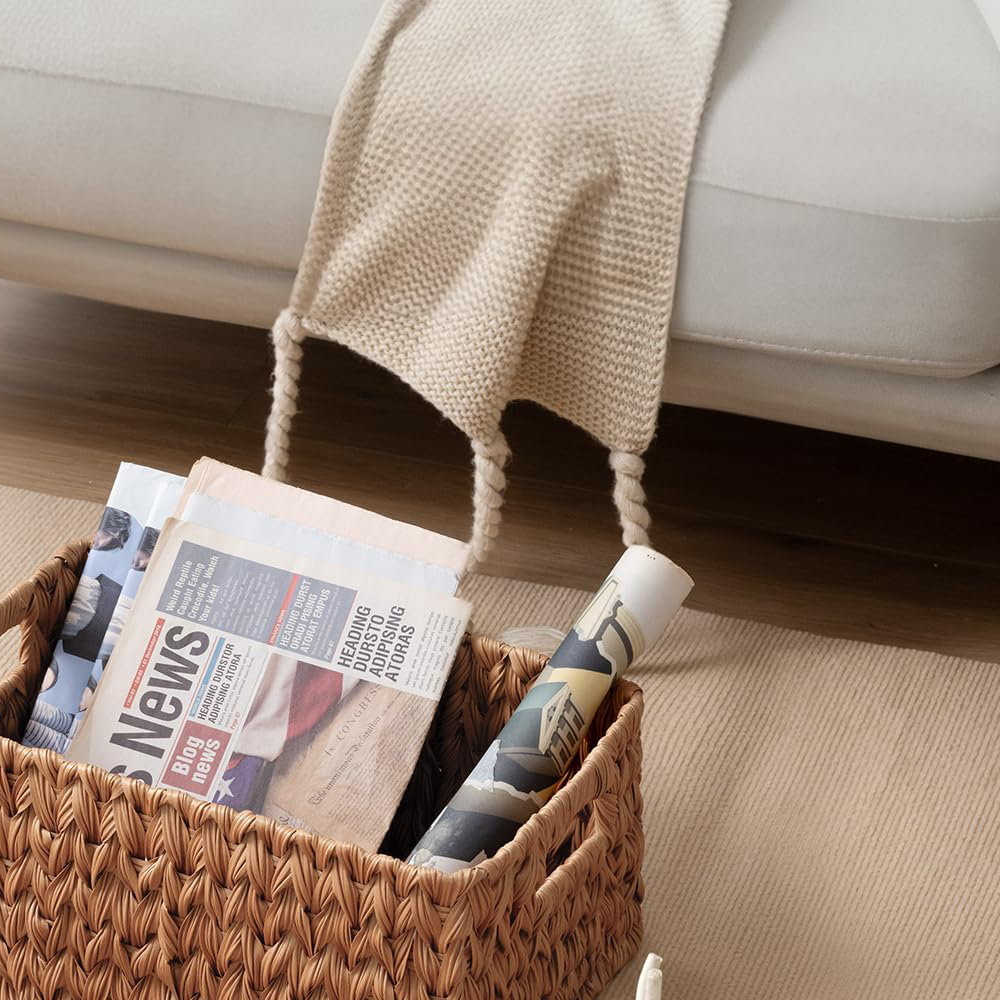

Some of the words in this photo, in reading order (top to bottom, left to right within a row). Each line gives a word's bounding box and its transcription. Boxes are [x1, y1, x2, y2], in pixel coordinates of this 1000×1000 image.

[166, 589, 180, 611] Weird
[175, 560, 192, 587] Reptile
[177, 588, 194, 615] Caught
[188, 563, 205, 587] Eating
[203, 555, 219, 579] Watch
[198, 602, 211, 622] Your
[280, 609, 300, 647] HEADING
[295, 579, 312, 608] DURST
[290, 622, 306, 649] ORADI
[301, 593, 318, 622] PISING
[300, 620, 319, 653] ATORAT
[313, 588, 331, 619] EMPUS
[337, 606, 371, 668] HEADING
[353, 614, 385, 673] DURSTO
[369, 606, 406, 678] ADIPISING
[384, 625, 416, 682] ATORAS
[109, 625, 210, 759] News
[197, 684, 218, 720] HEADING
[213, 643, 235, 683] DURSTOR
[208, 682, 230, 724] ADIPISING
[227, 654, 242, 682] ATORA
[171, 736, 205, 776] Blog
[191, 738, 221, 784] news
